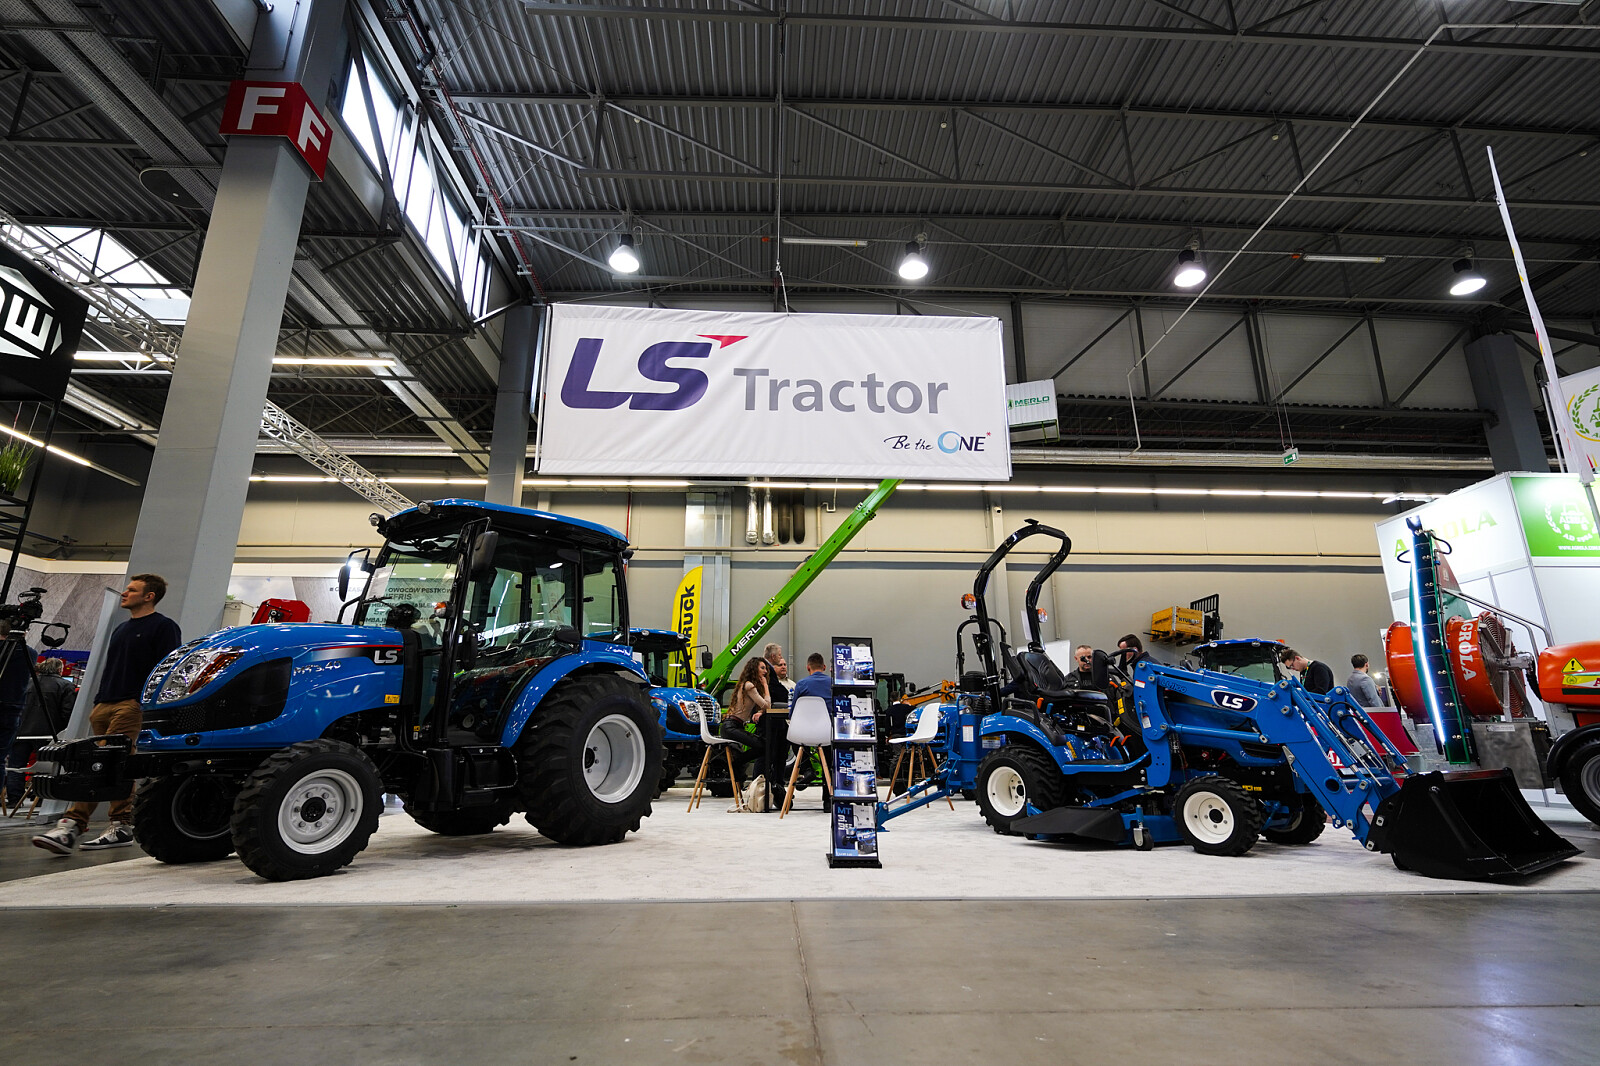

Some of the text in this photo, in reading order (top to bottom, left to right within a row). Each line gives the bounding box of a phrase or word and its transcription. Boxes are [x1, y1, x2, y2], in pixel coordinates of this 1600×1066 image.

[237, 87, 286, 130] F
[297, 101, 326, 153] F
[561, 338, 948, 414] LS Tractor
[1015, 396, 1050, 406] MERLO
[883, 435, 911, 450] Be
[915, 438, 934, 450] the
[730, 616, 767, 656] MERLO
[374, 650, 399, 664] LS
[1459, 618, 1477, 681] GROLA
[1221, 695, 1244, 709] LS
[839, 752, 853, 760] LS
[837, 806, 852, 815] MT
